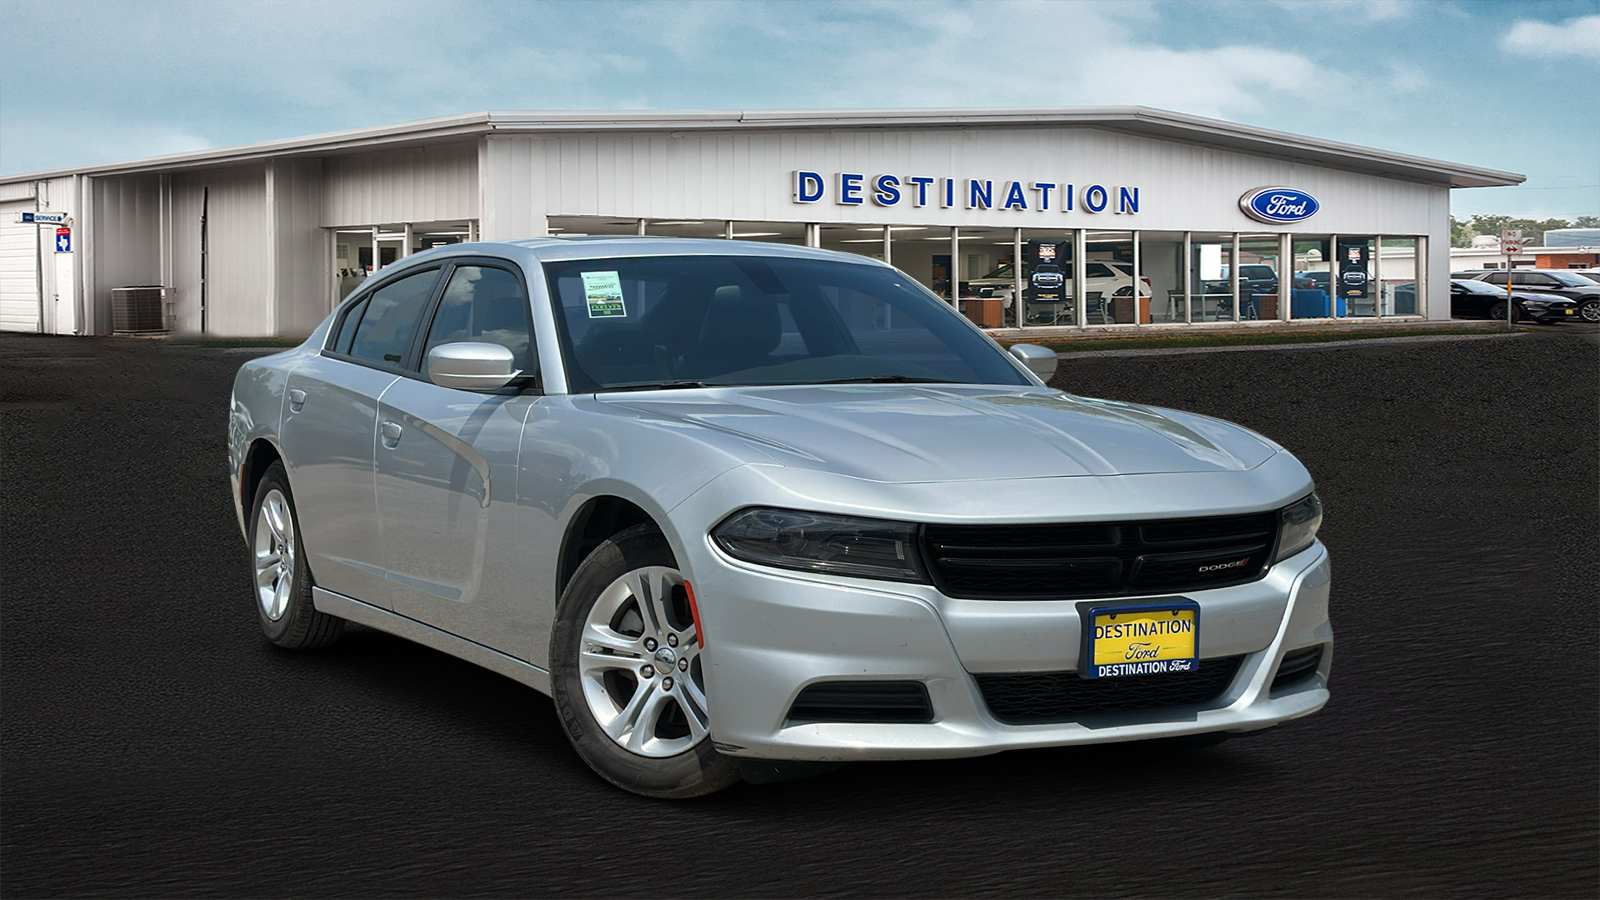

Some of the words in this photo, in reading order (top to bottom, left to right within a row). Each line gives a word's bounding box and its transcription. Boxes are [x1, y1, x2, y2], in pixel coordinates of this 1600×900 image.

[793, 170, 1141, 214] DESTINATION
[1266, 194, 1307, 215] Ford
[1199, 560, 1245, 572] DODGE
[1095, 619, 1191, 640] DESTINATION
[1125, 642, 1160, 660] Ford
[1099, 661, 1168, 677] DESTINATION
[1169, 659, 1191, 671] Ford
